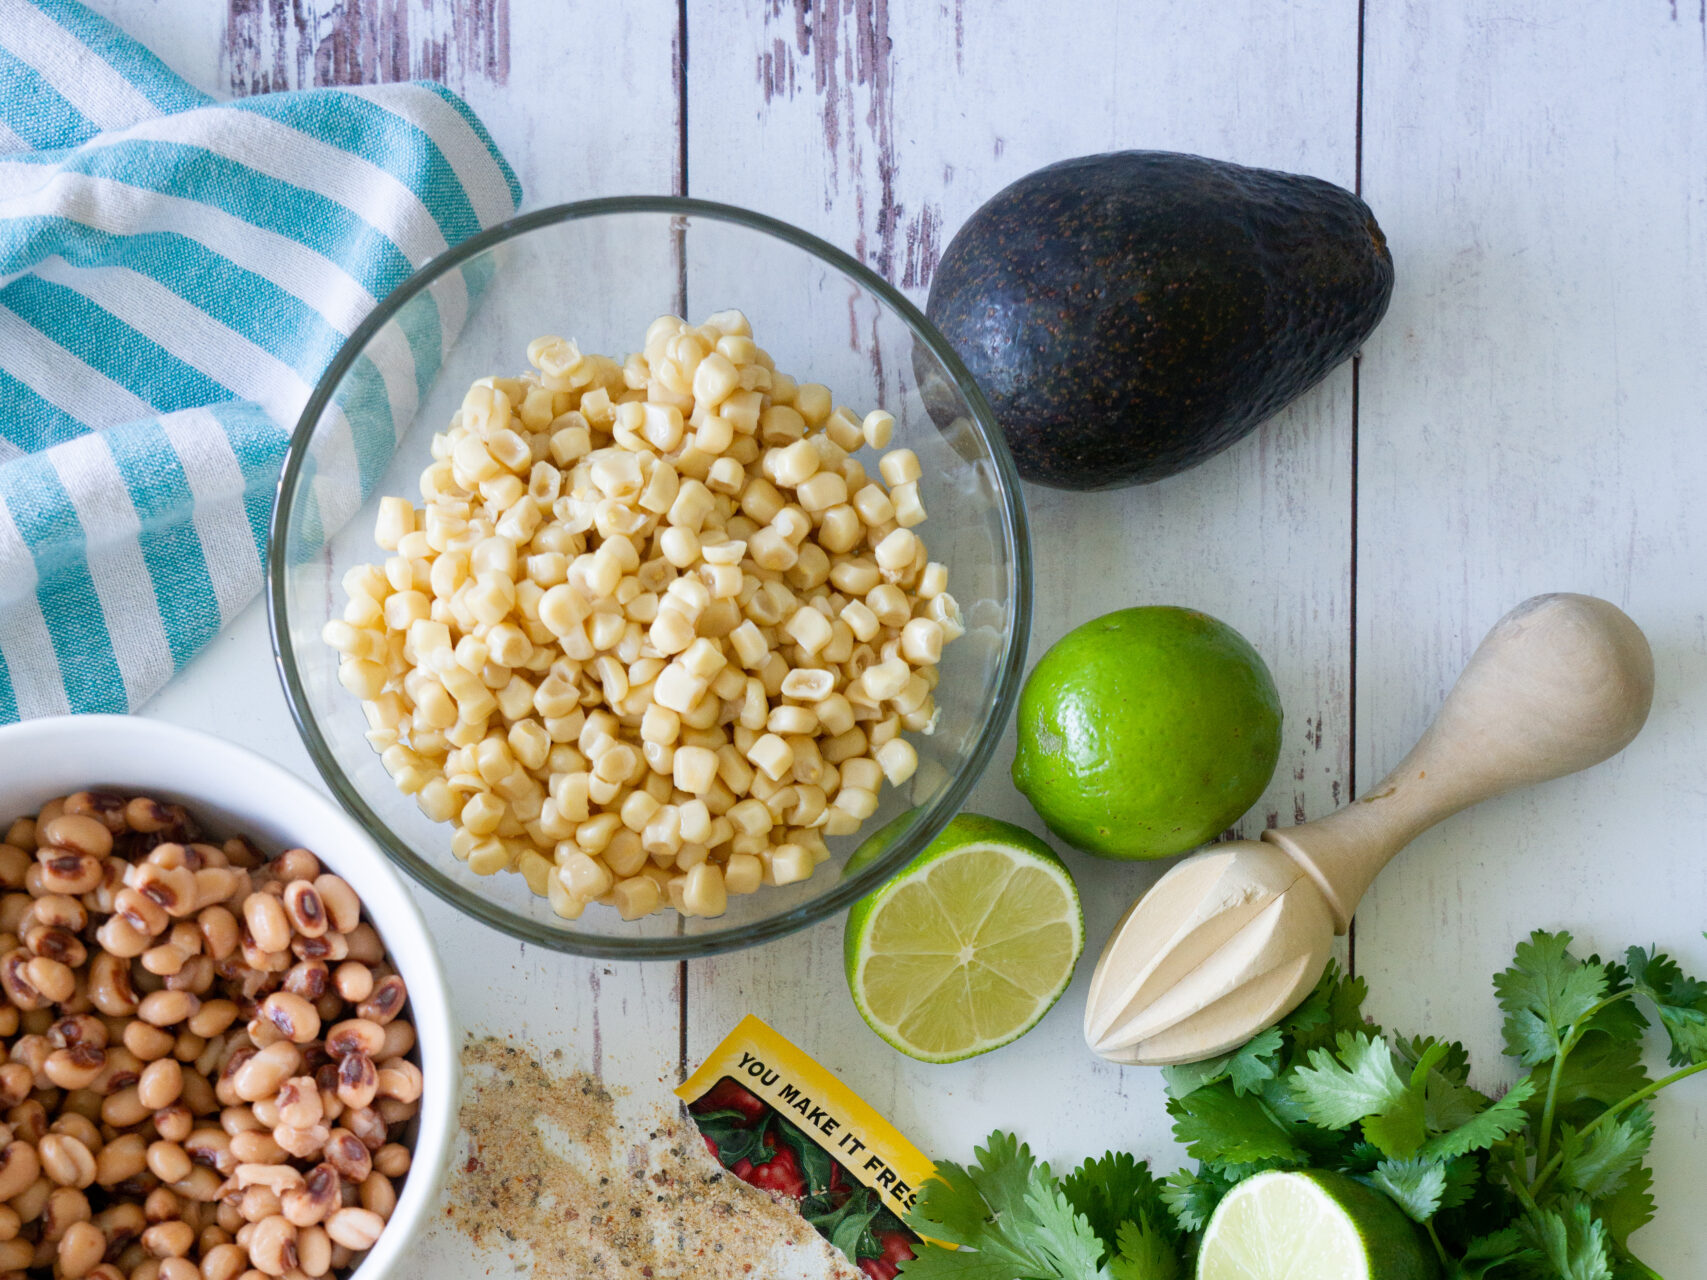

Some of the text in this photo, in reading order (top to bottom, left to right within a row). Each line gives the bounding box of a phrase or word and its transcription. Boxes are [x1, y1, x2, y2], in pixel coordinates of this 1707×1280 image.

[737, 1052, 918, 1212] YOU MAKE IT FRES
